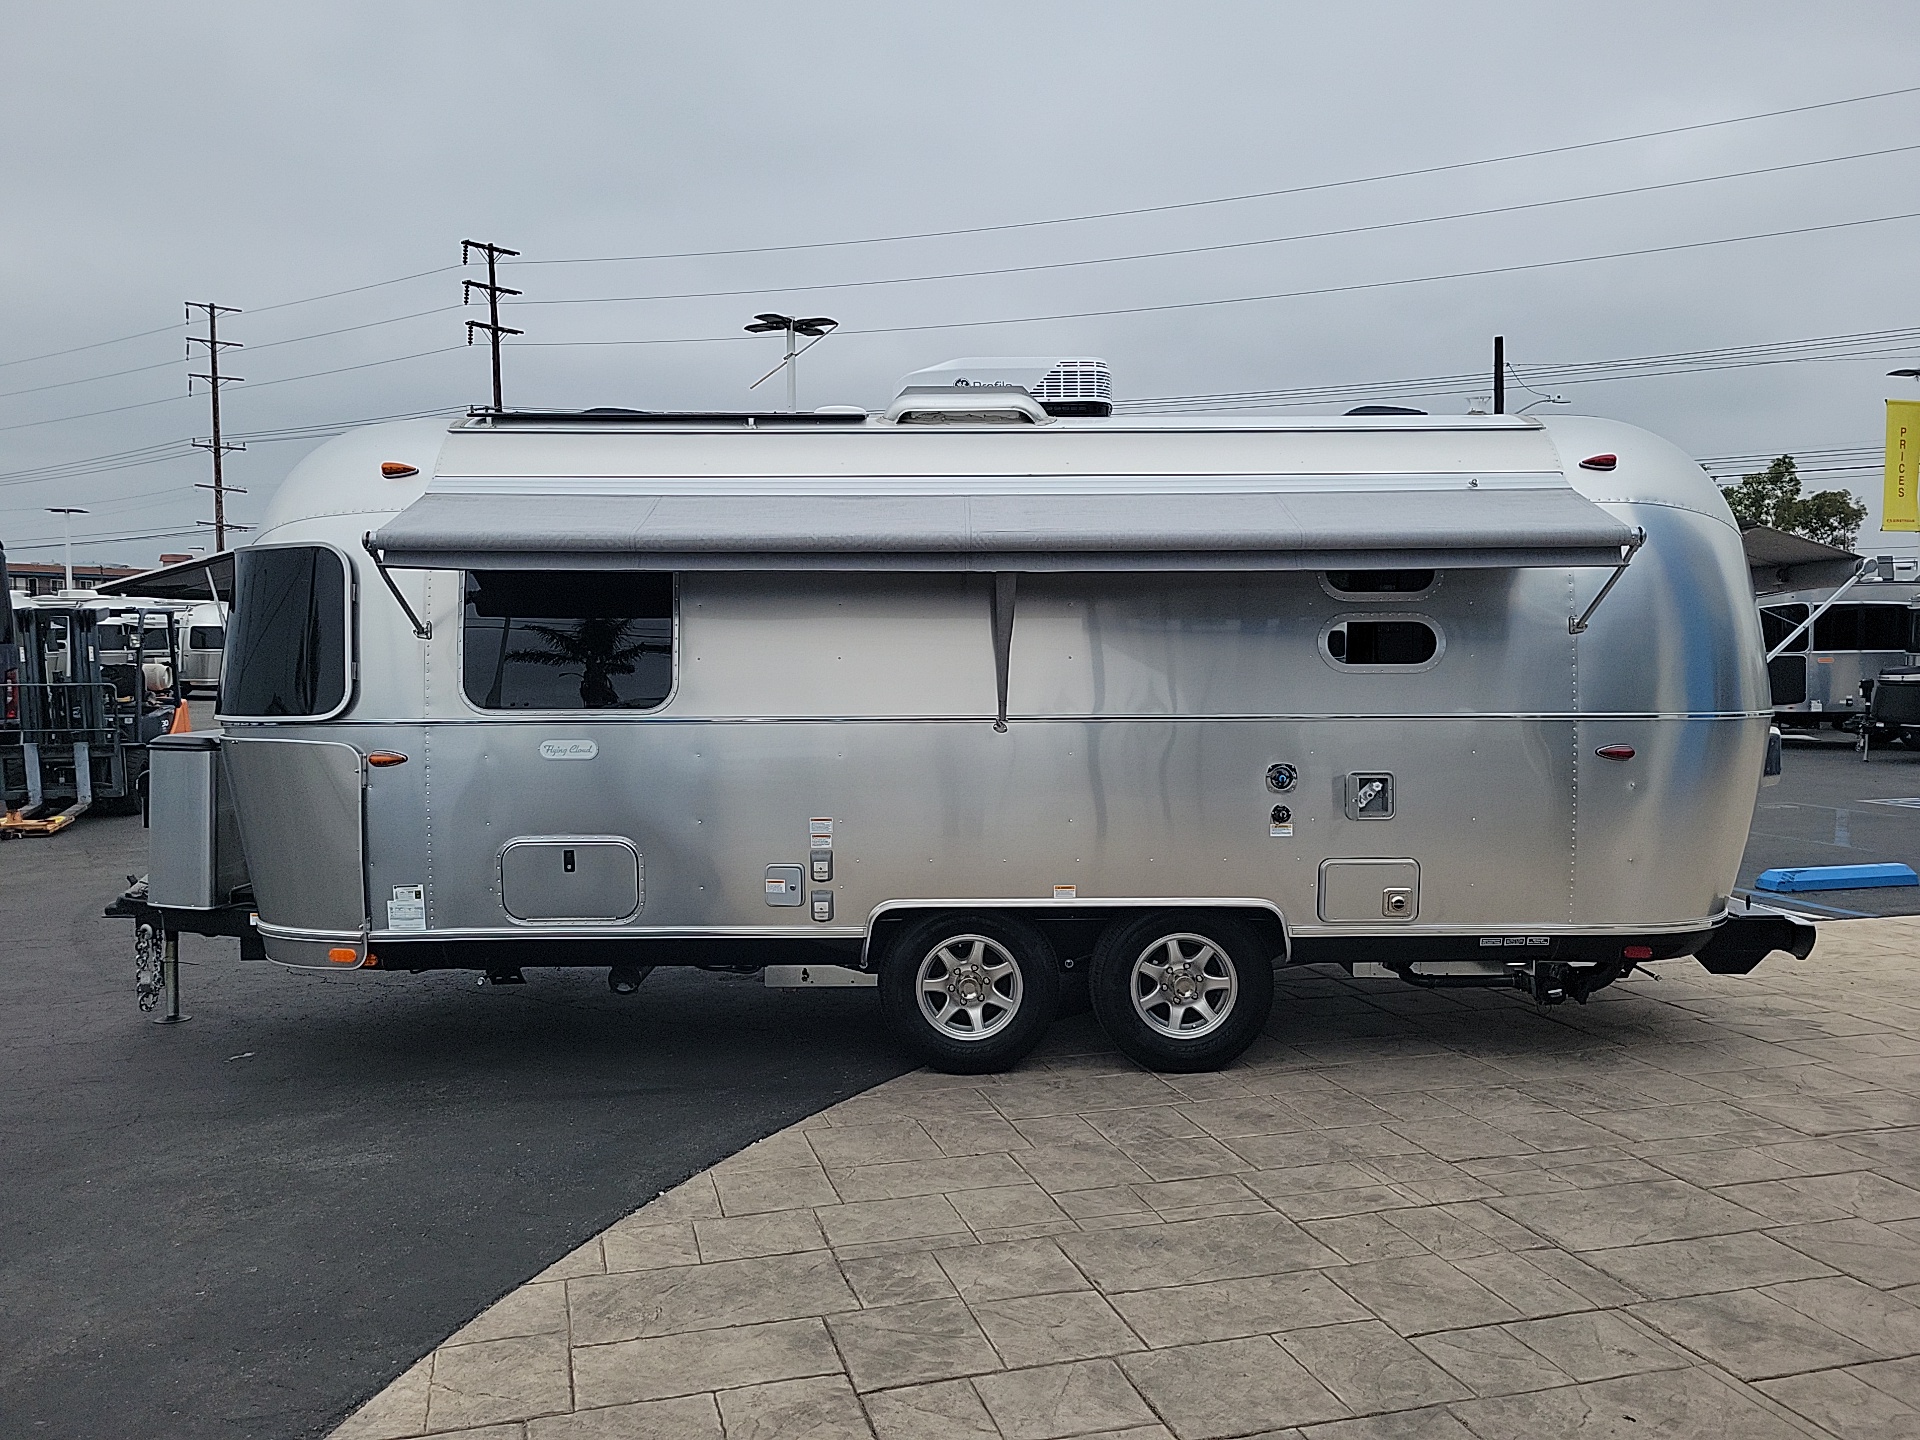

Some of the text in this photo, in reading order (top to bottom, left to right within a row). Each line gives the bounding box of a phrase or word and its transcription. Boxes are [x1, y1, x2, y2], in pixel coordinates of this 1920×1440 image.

[1898, 427, 1907, 498] PRICES
[543, 744, 593, 756] Flying Cloud
